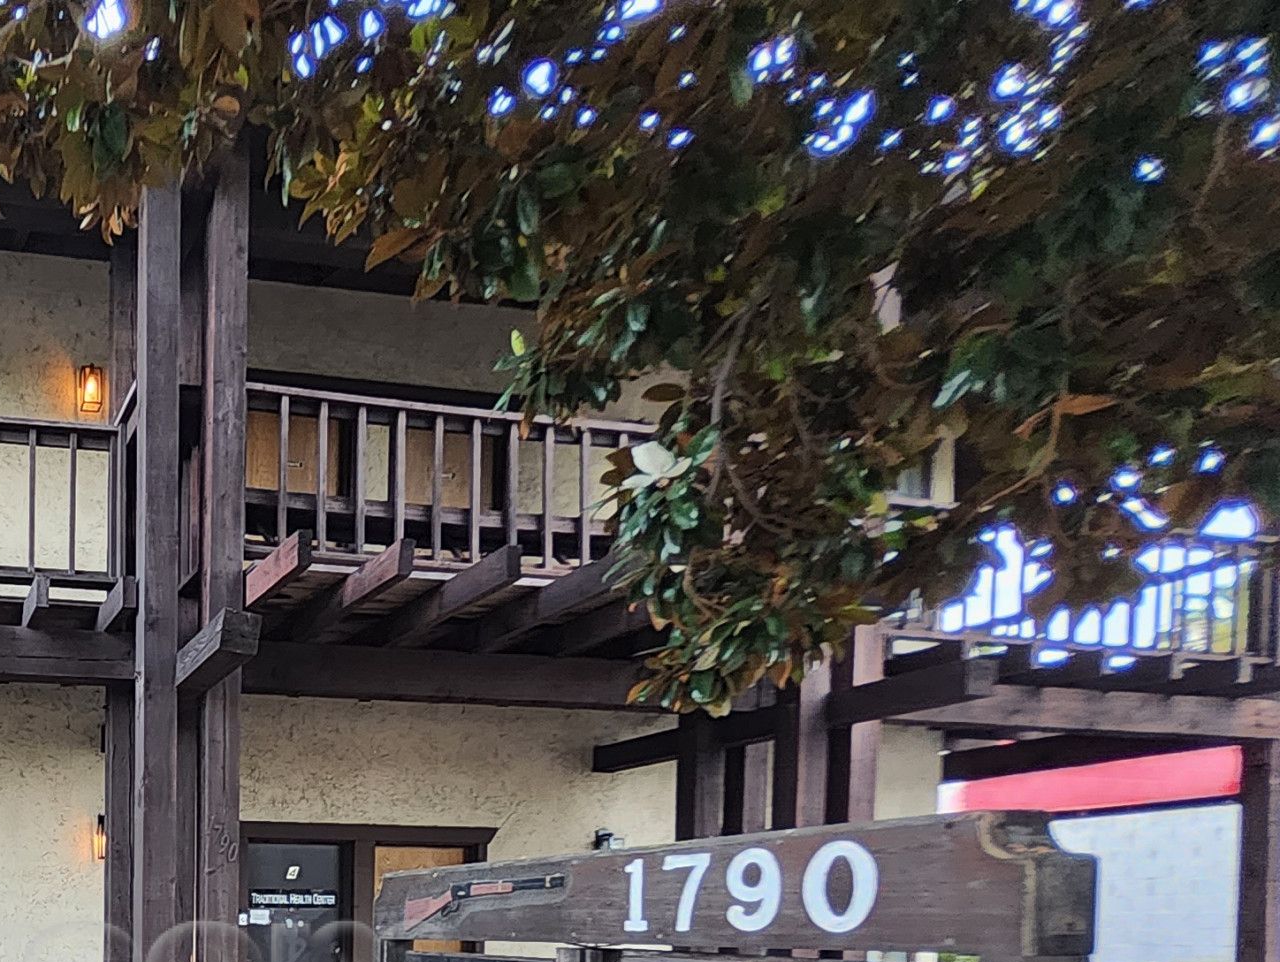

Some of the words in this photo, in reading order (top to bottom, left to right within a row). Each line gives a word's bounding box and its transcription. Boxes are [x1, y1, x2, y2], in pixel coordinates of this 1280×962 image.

[251, 892, 289, 905] TRADITIONAL
[290, 893, 312, 905] HEALTH
[313, 893, 336, 906] CENTER
[623, 839, 879, 933] 1790
